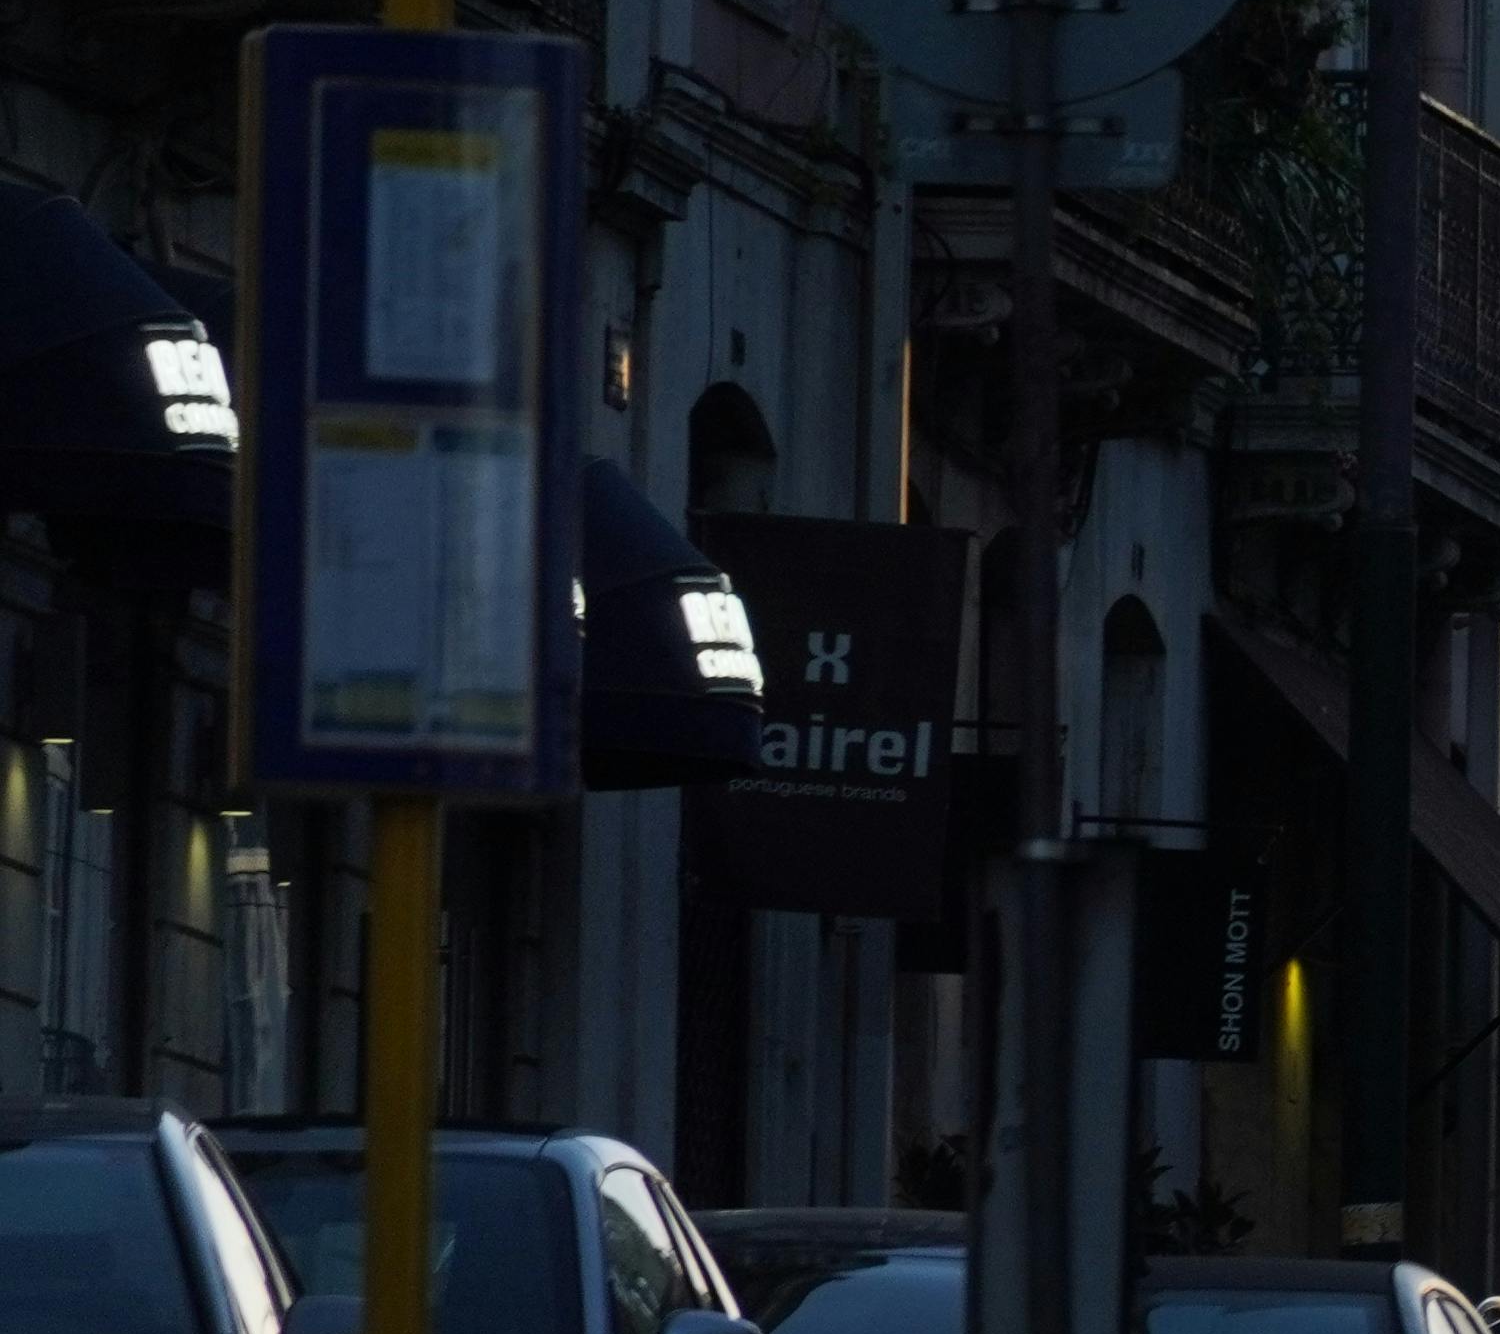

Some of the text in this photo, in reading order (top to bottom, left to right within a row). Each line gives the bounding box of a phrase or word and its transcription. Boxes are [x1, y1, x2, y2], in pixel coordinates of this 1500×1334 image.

[758, 713, 933, 778] airel
[728, 776, 907, 802] portuguese brands
[1218, 888, 1252, 1052] SHON MOTT
